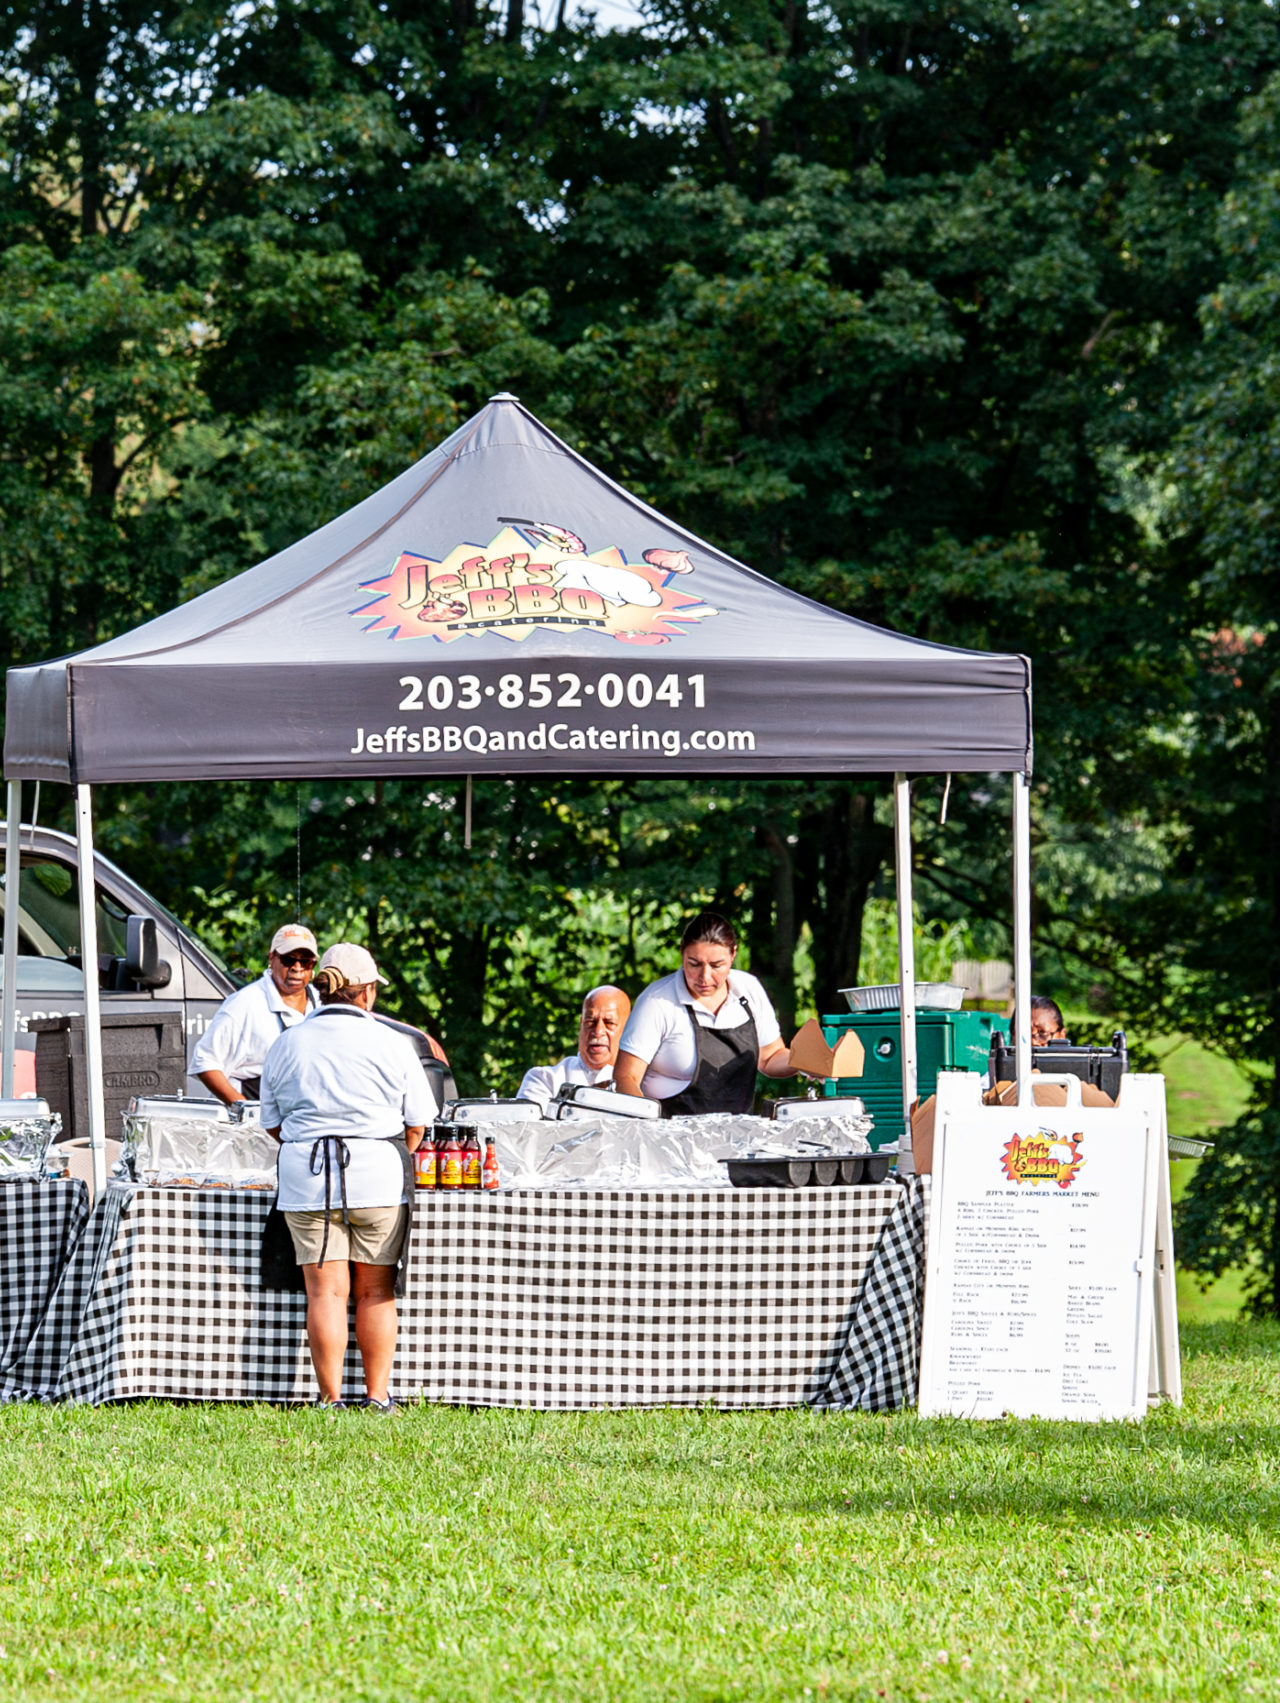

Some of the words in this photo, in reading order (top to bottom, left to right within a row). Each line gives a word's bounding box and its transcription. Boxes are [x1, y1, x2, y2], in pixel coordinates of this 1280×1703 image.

[398, 553, 554, 609] Jeff's
[468, 584, 609, 620] BBQ
[351, 723, 756, 757] JeffsBBQandCatering.com
[1027, 1157, 1059, 1174] BBQ
